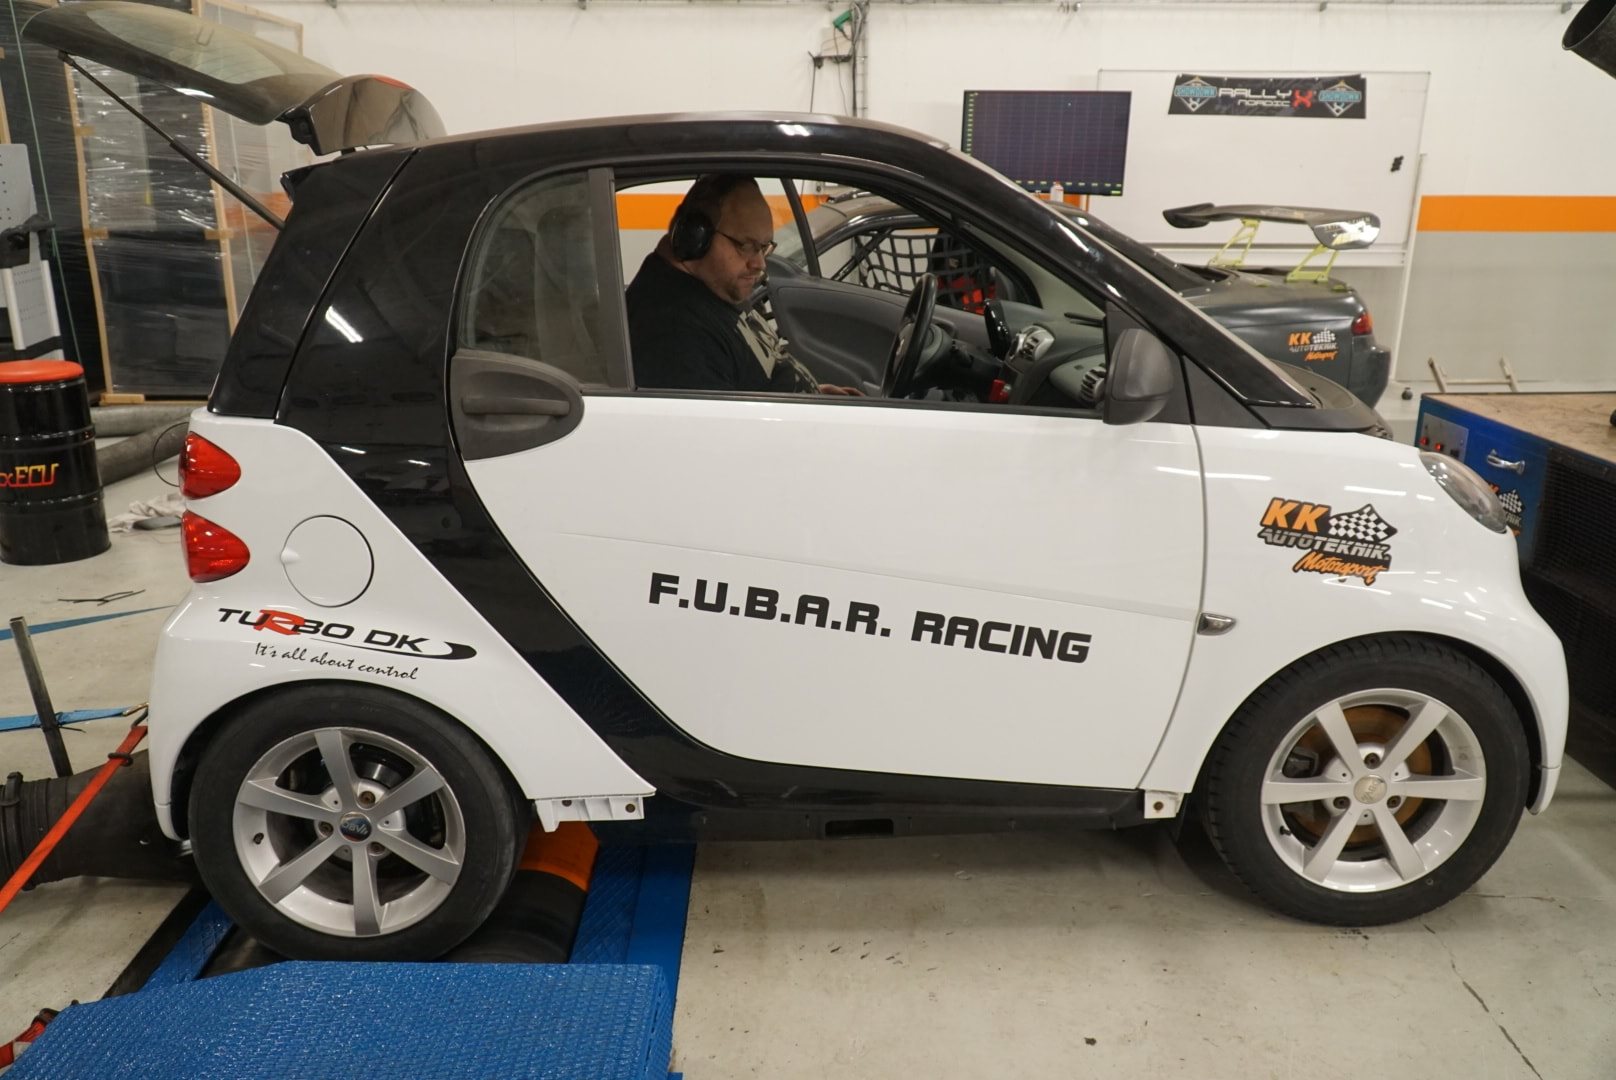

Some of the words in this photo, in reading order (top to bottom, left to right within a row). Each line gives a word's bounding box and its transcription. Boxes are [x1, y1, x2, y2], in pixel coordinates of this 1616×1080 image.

[1288, 332, 1312, 346] KK
[1260, 497, 1331, 534] KK
[1293, 550, 1389, 585] Motorsport
[218, 607, 355, 640] TURBO
[363, 629, 430, 653] DK
[649, 572, 891, 638] F.U.B.A.R.
[911, 610, 1092, 664] RACING
[281, 648, 306, 662] all
[310, 654, 354, 670] about
[358, 663, 418, 680] control
